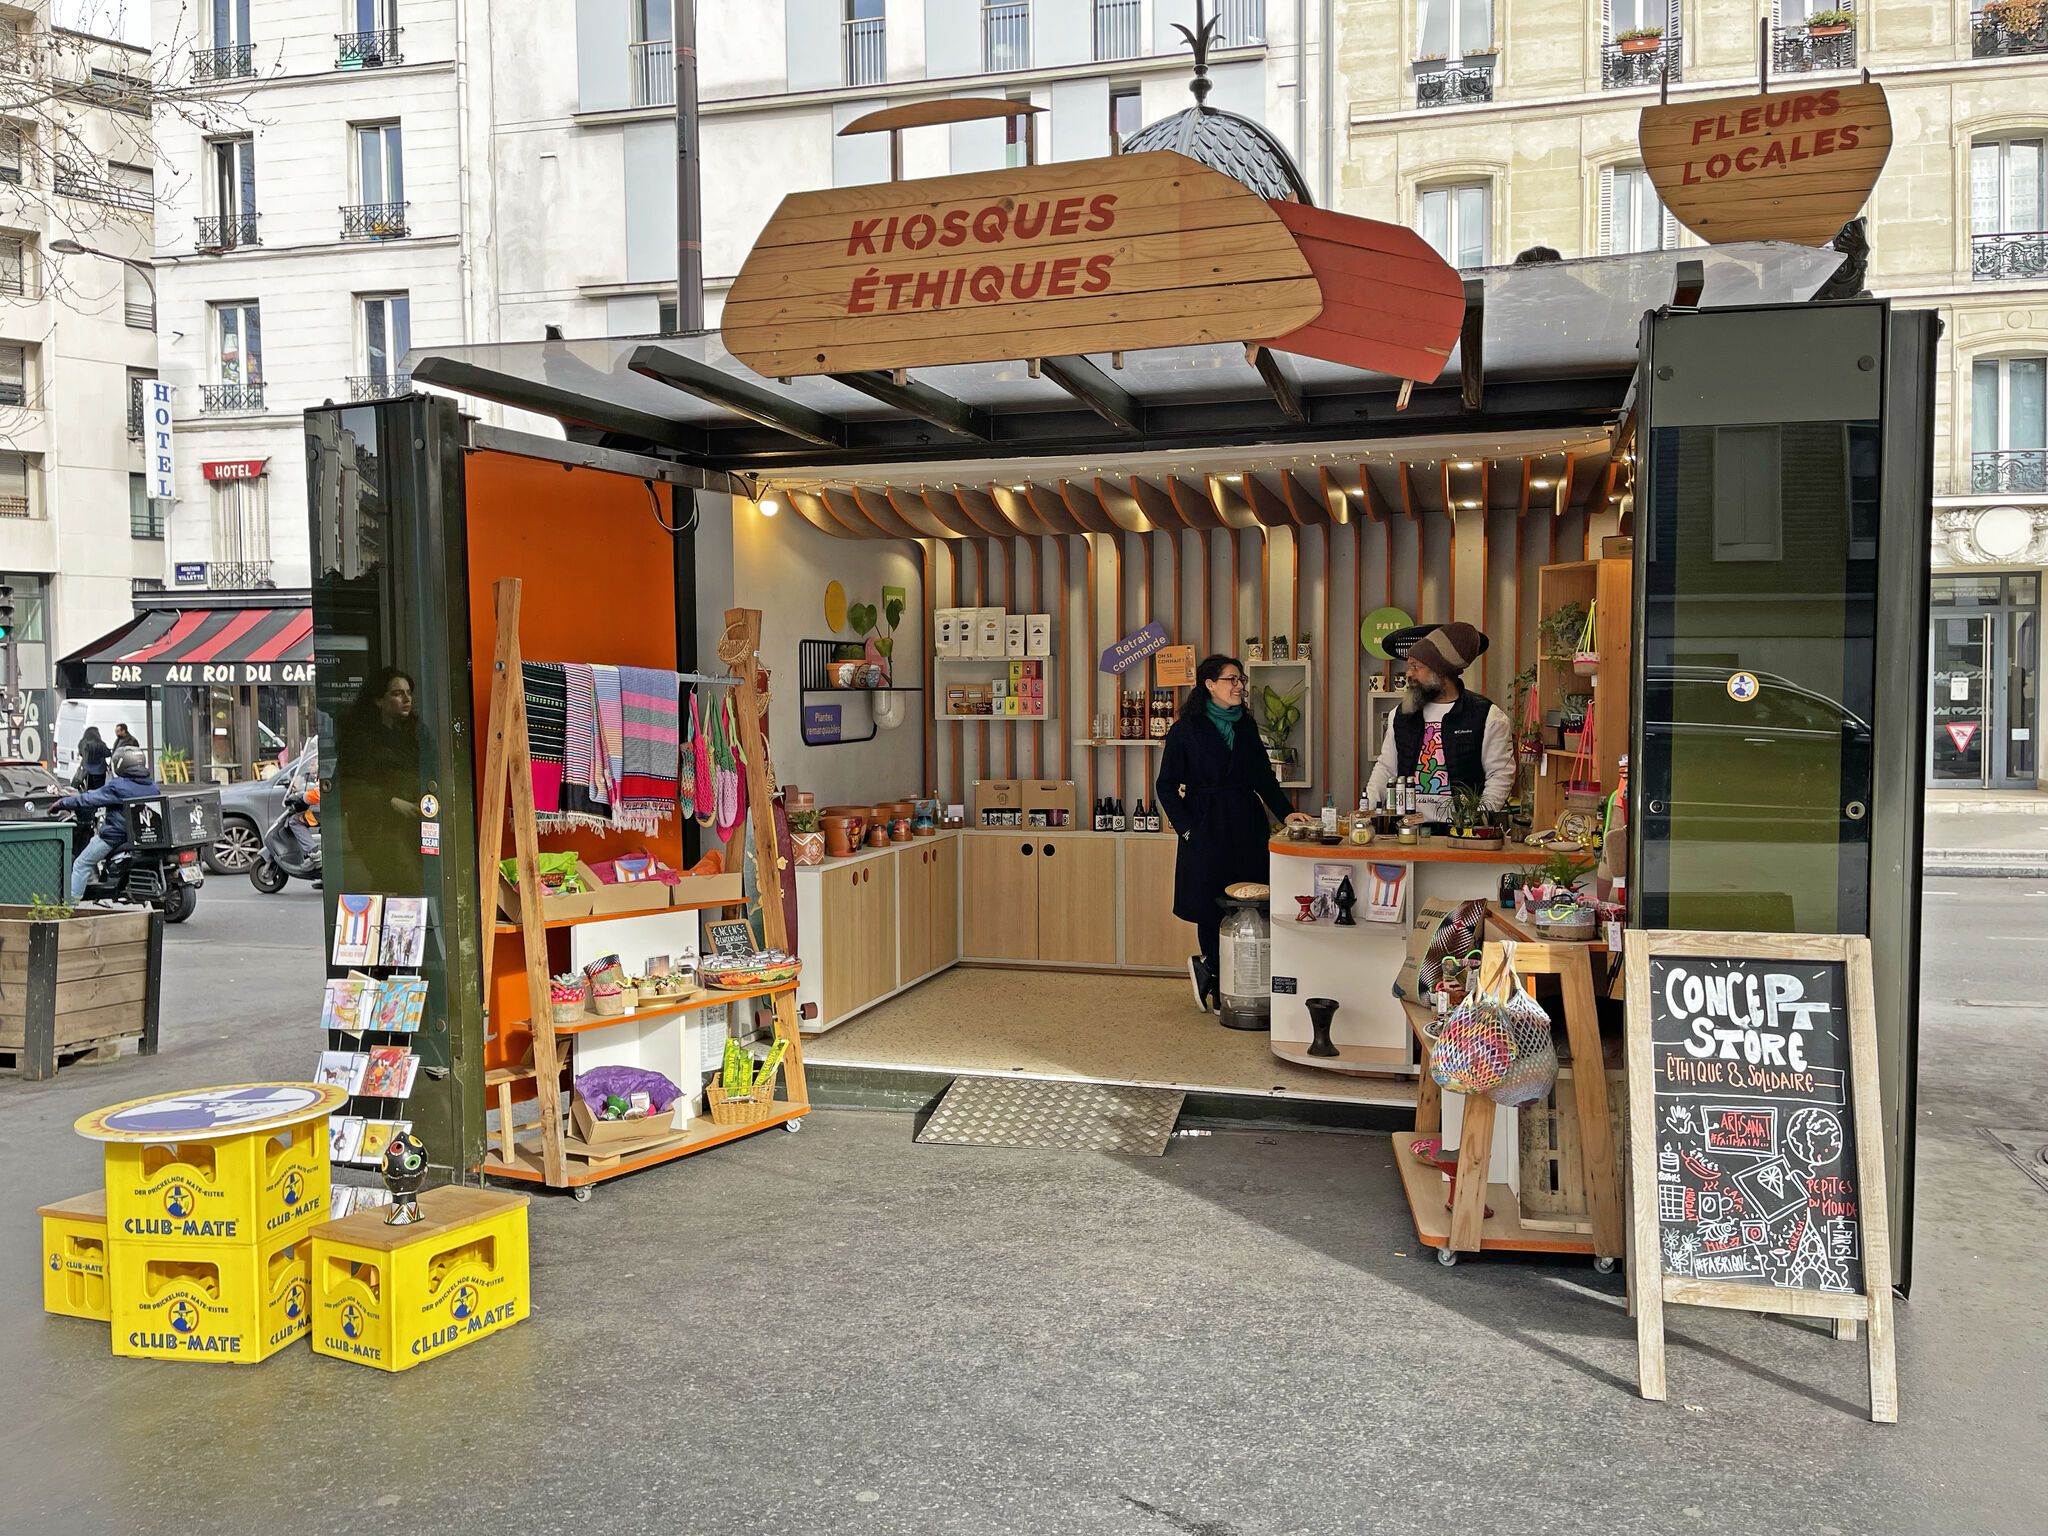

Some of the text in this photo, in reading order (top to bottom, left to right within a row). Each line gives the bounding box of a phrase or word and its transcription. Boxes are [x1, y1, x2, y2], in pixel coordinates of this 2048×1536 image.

[1691, 90, 1841, 146] FLEURS
[1682, 124, 1860, 185] LOCALES
[845, 193, 1118, 257] KIOSQUES
[846, 253, 1116, 315] ÉTHIQUES
[153, 383, 172, 498] HOTEL
[214, 463, 251, 478] HOTEL
[1112, 636, 1166, 672] commande
[1115, 630, 1151, 656] Retrait
[111, 665, 142, 682] BAR
[166, 665, 316, 682] AU ROI DU CAF
[815, 712, 833, 722] Plantes
[807, 725, 841, 736] remarquables
[713, 925, 742, 937] ENCENS
[1666, 968, 1830, 1030] CONCEPT
[1684, 1017, 1808, 1072] STORE
[1727, 1062, 1747, 1088] &
[1748, 1065, 1814, 1093] SOLIDAIRE
[266, 1198, 320, 1230] CLUB-MATE
[1808, 1199, 1857, 1217] DU MONDE
[124, 1218, 237, 1237] CLUB-MATE
[1831, 1230, 1853, 1255] PARIS
[66, 1261, 103, 1273] CLUB-MATE
[422, 1303, 434, 1313] DER
[270, 1313, 312, 1345] CLUB-MA
[411, 1301, 516, 1355] CLUB-MATE
[129, 1331, 241, 1353] CLUB-MATE
[325, 1337, 381, 1360] CLUB-MATE
